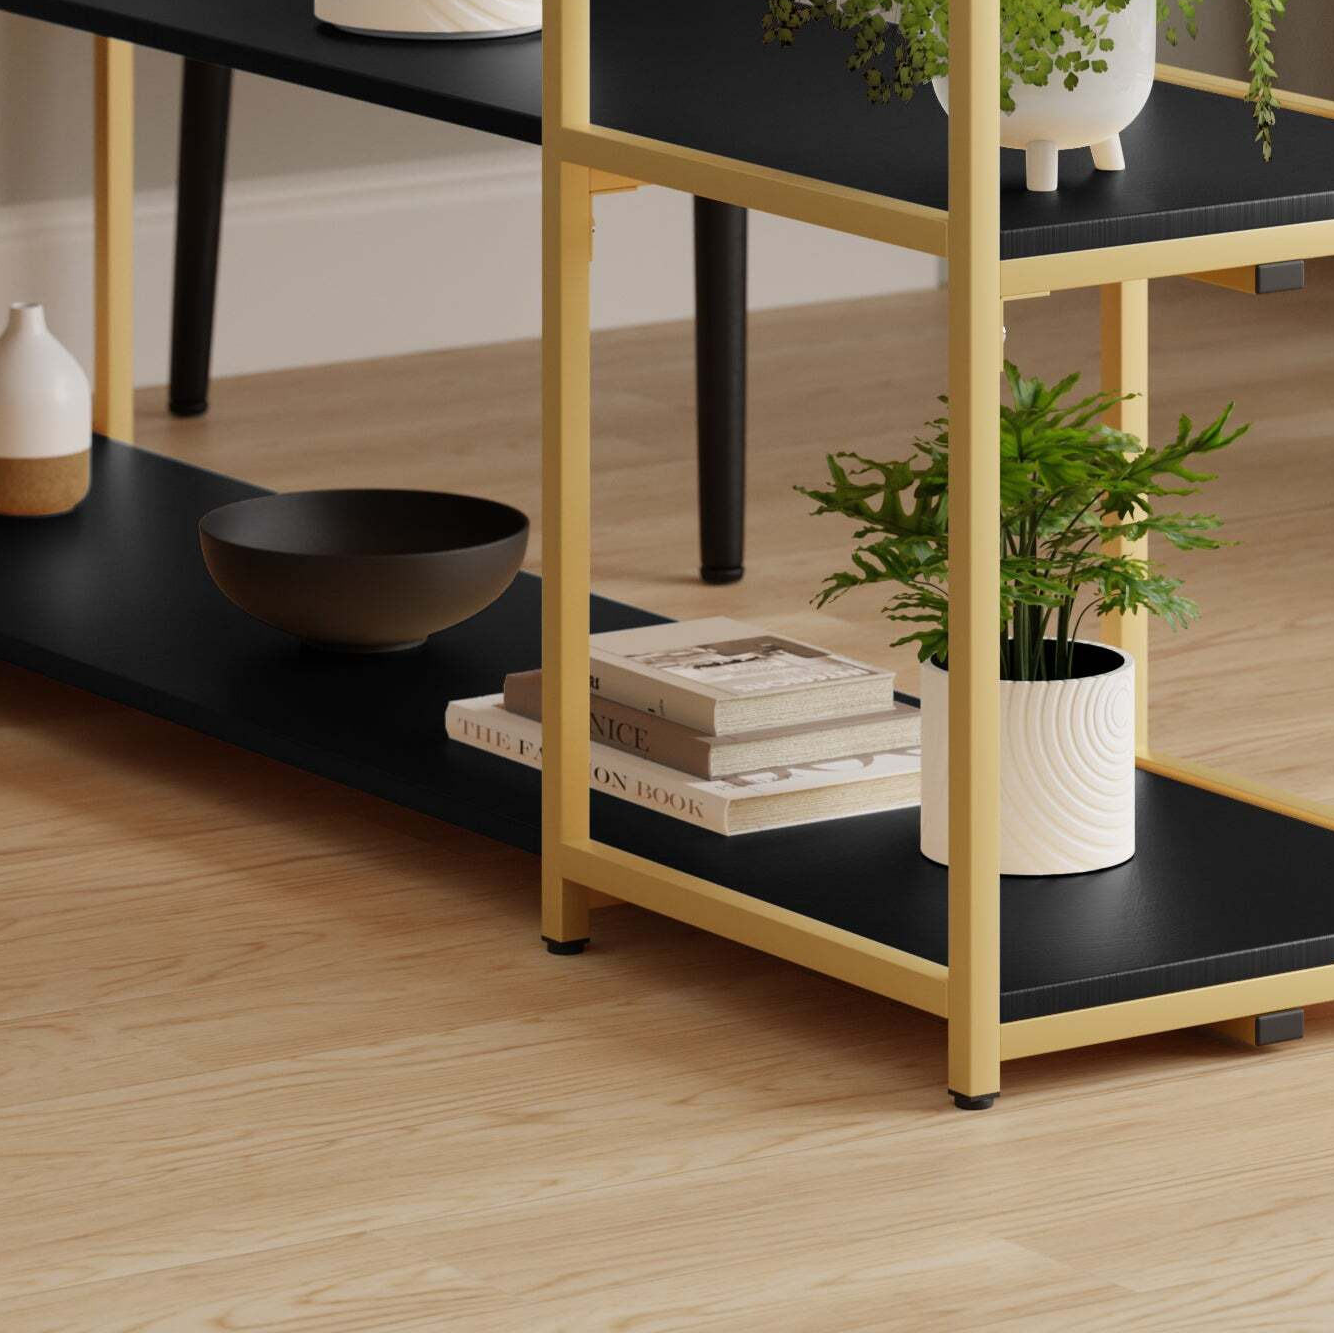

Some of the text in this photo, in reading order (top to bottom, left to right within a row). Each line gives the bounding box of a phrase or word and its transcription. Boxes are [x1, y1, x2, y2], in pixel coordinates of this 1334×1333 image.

[458, 717, 511, 751] THE
[637, 780, 704, 819] BOOK
[590, 712, 650, 753] NICE
